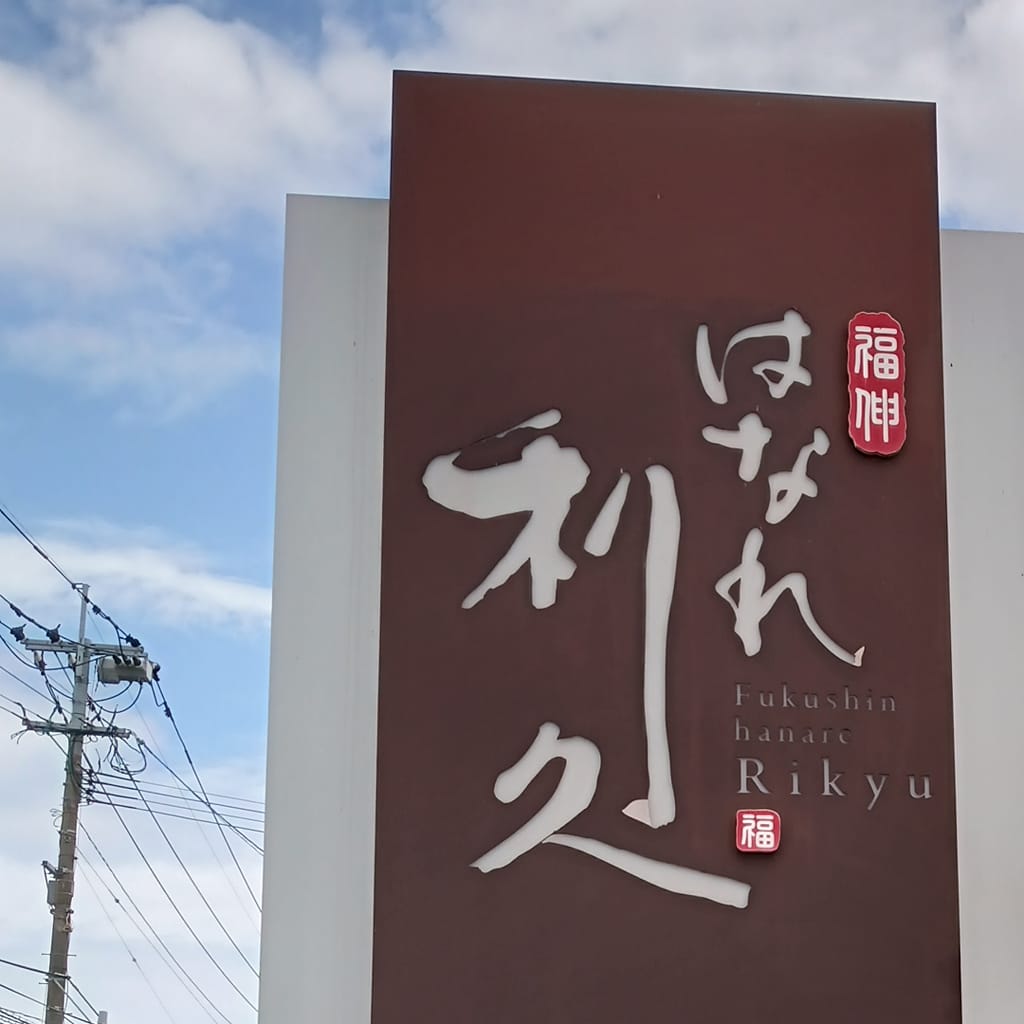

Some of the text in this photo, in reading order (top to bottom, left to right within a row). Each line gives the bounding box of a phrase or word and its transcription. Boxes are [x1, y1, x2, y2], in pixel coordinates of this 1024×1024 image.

[854, 326, 899, 443] 福伸
[696, 310, 866, 667] はなれ
[422, 409, 752, 908] 利久
[735, 683, 896, 712] Fukushin
[735, 717, 851, 744] hanare
[737, 757, 933, 811] Rikyu
[741, 814, 775, 849] 福
